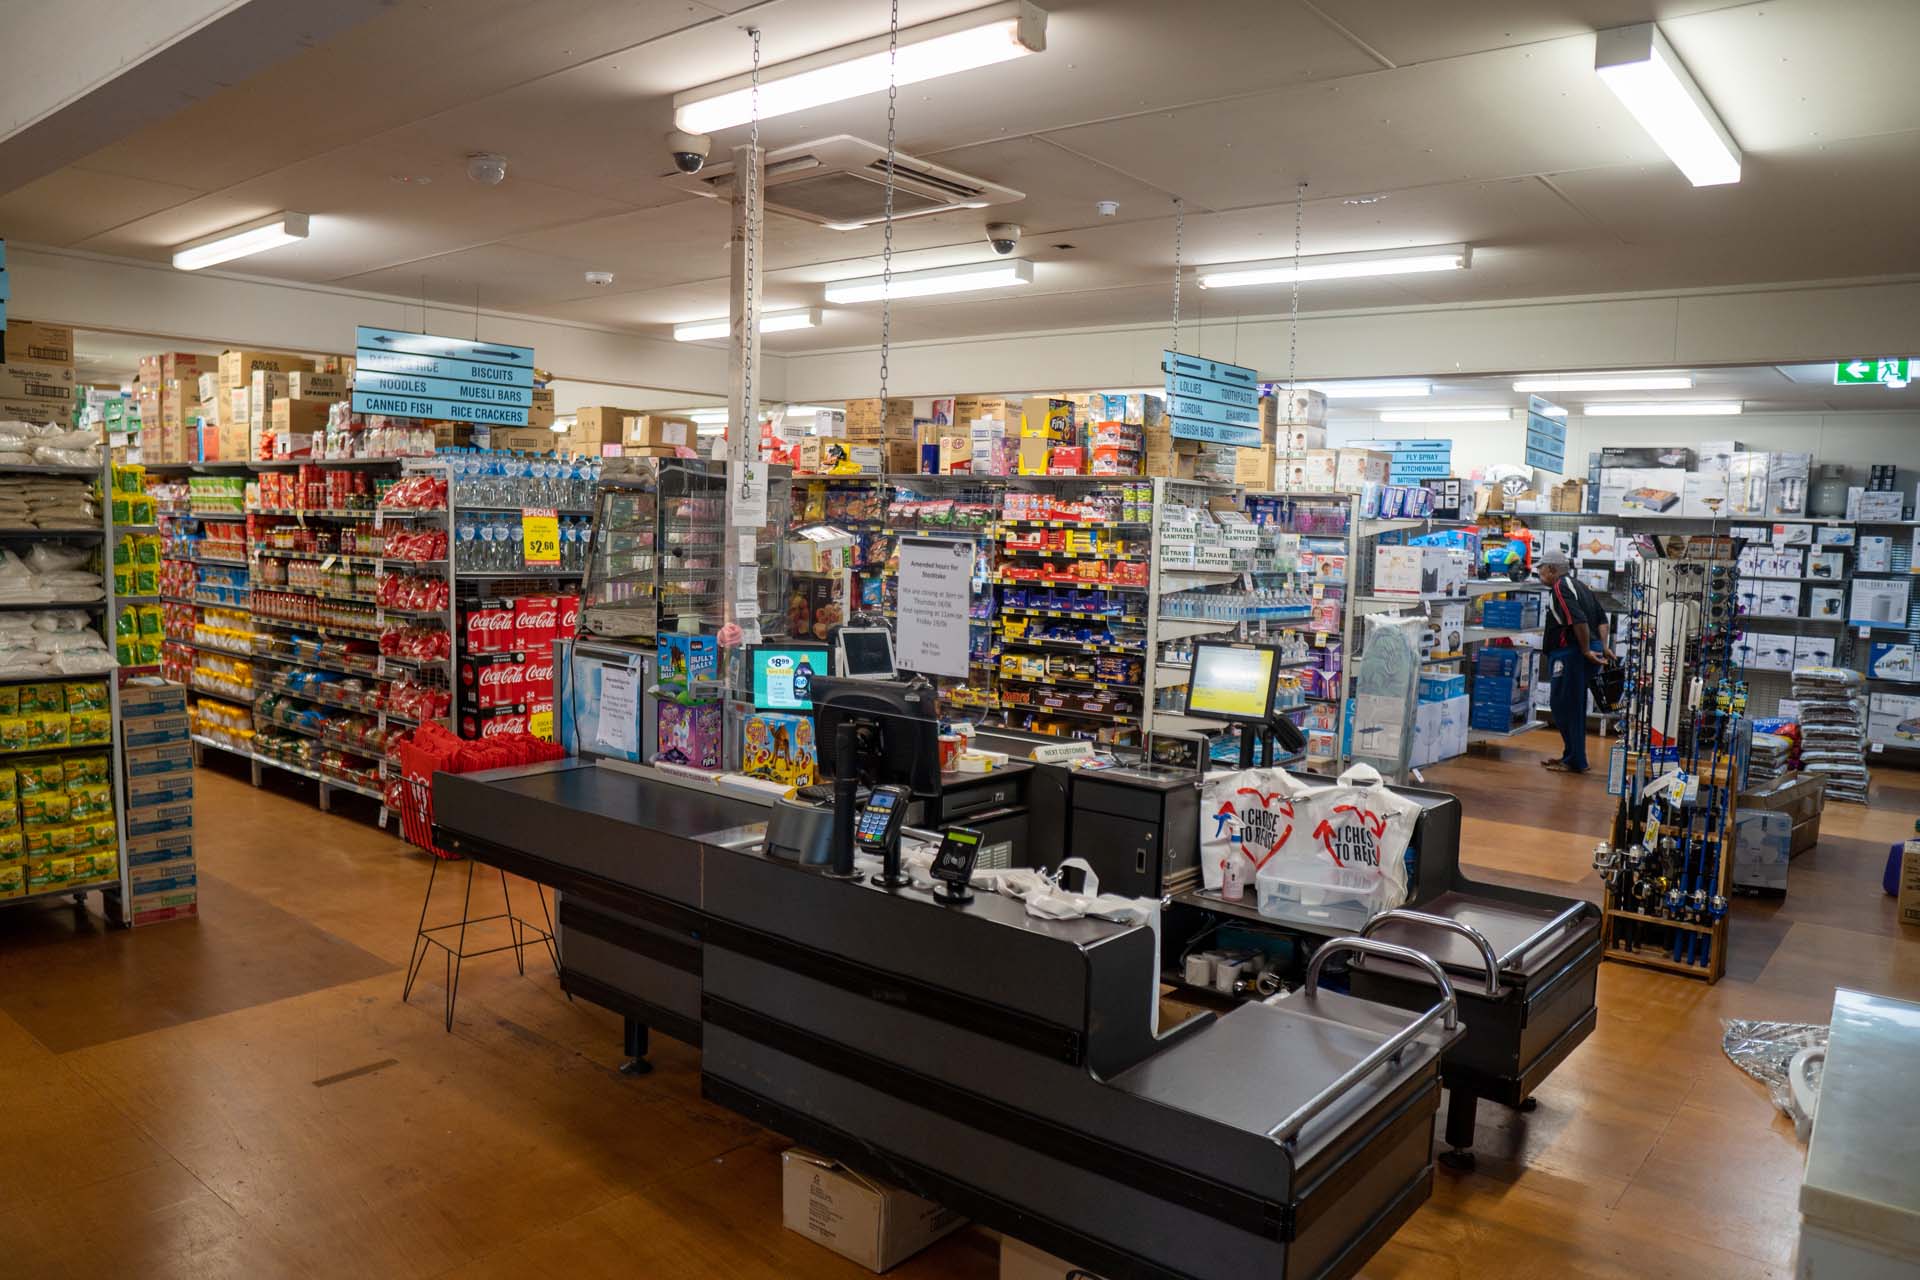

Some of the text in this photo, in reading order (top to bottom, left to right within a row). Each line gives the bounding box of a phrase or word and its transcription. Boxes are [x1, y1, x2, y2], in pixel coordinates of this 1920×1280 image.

[471, 366, 513, 381] BISCUITS
[379, 379, 427, 393] NOODLES
[460, 385, 522, 402] MUESLI BARS
[1180, 381, 1202, 395] LOLLIES
[1221, 388, 1252, 404] TOOTHPASTE
[366, 398, 433, 415] CANNED FISH
[451, 406, 523, 423] RICE CRACKERS
[1180, 402, 1204, 416] CORDIAL
[1175, 421, 1214, 438] RUBBISH BAGS
[524, 508, 556, 517] SPECIAL
[530, 540, 554, 554] $2.60
[911, 560, 934, 568] Amended
[468, 613, 514, 631] Coca-Cola
[516, 611, 557, 629] Coca-Cola
[480, 666, 526, 686] Coca-Cola
[1059, 746, 1087, 755] CUSTOMER
[1248, 808, 1280, 833] CHOSE
[1240, 826, 1252, 843] TO
[1338, 827, 1342, 841] I
[1335, 843, 1350, 861] TO
